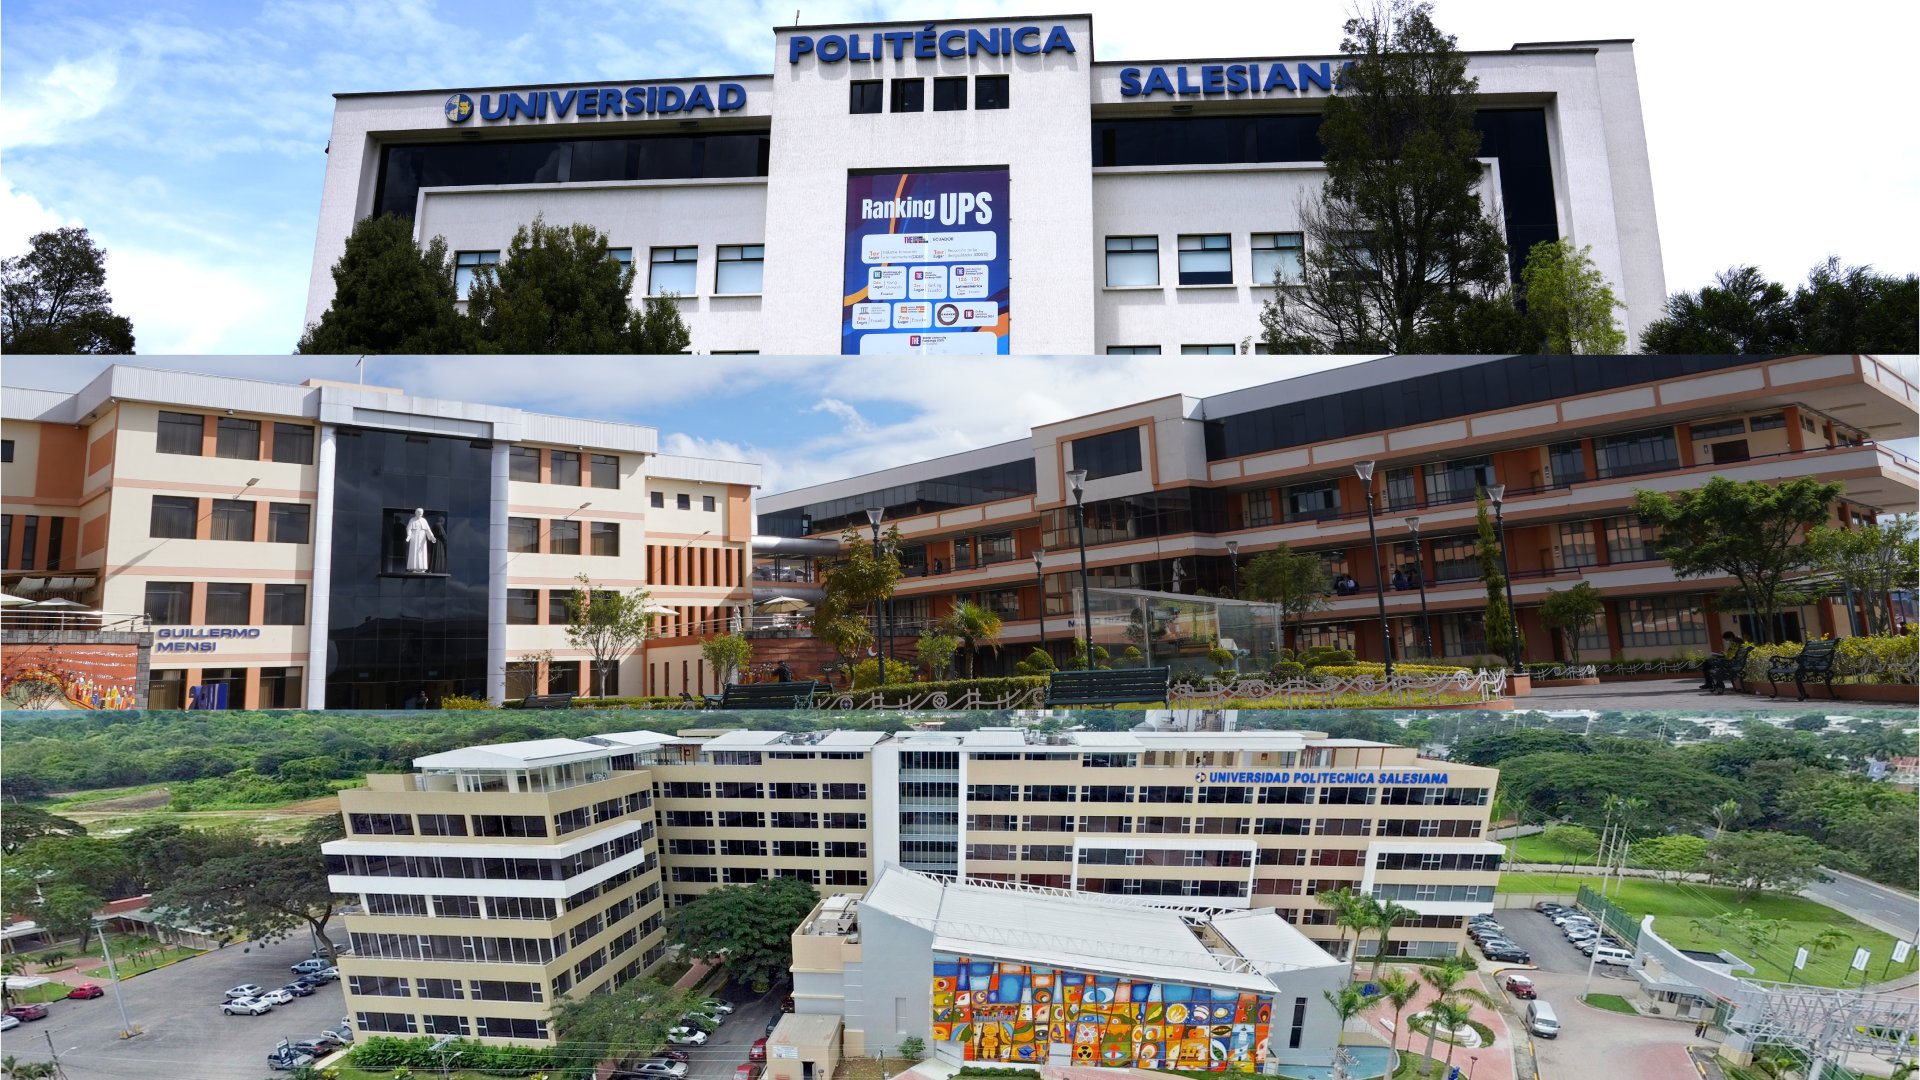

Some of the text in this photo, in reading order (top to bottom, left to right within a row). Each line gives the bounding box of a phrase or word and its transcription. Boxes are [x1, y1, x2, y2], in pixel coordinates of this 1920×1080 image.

[789, 24, 1076, 64] POLITÉCNICA
[479, 83, 747, 120] UNIVERSIDAD
[862, 191, 993, 226] Ranking UPS
[158, 628, 260, 639] GUILLERMO
[156, 641, 217, 652] MENSI
[1209, 771, 1449, 785] UNIVERSIDAD POLITECNICA SALESIANA
